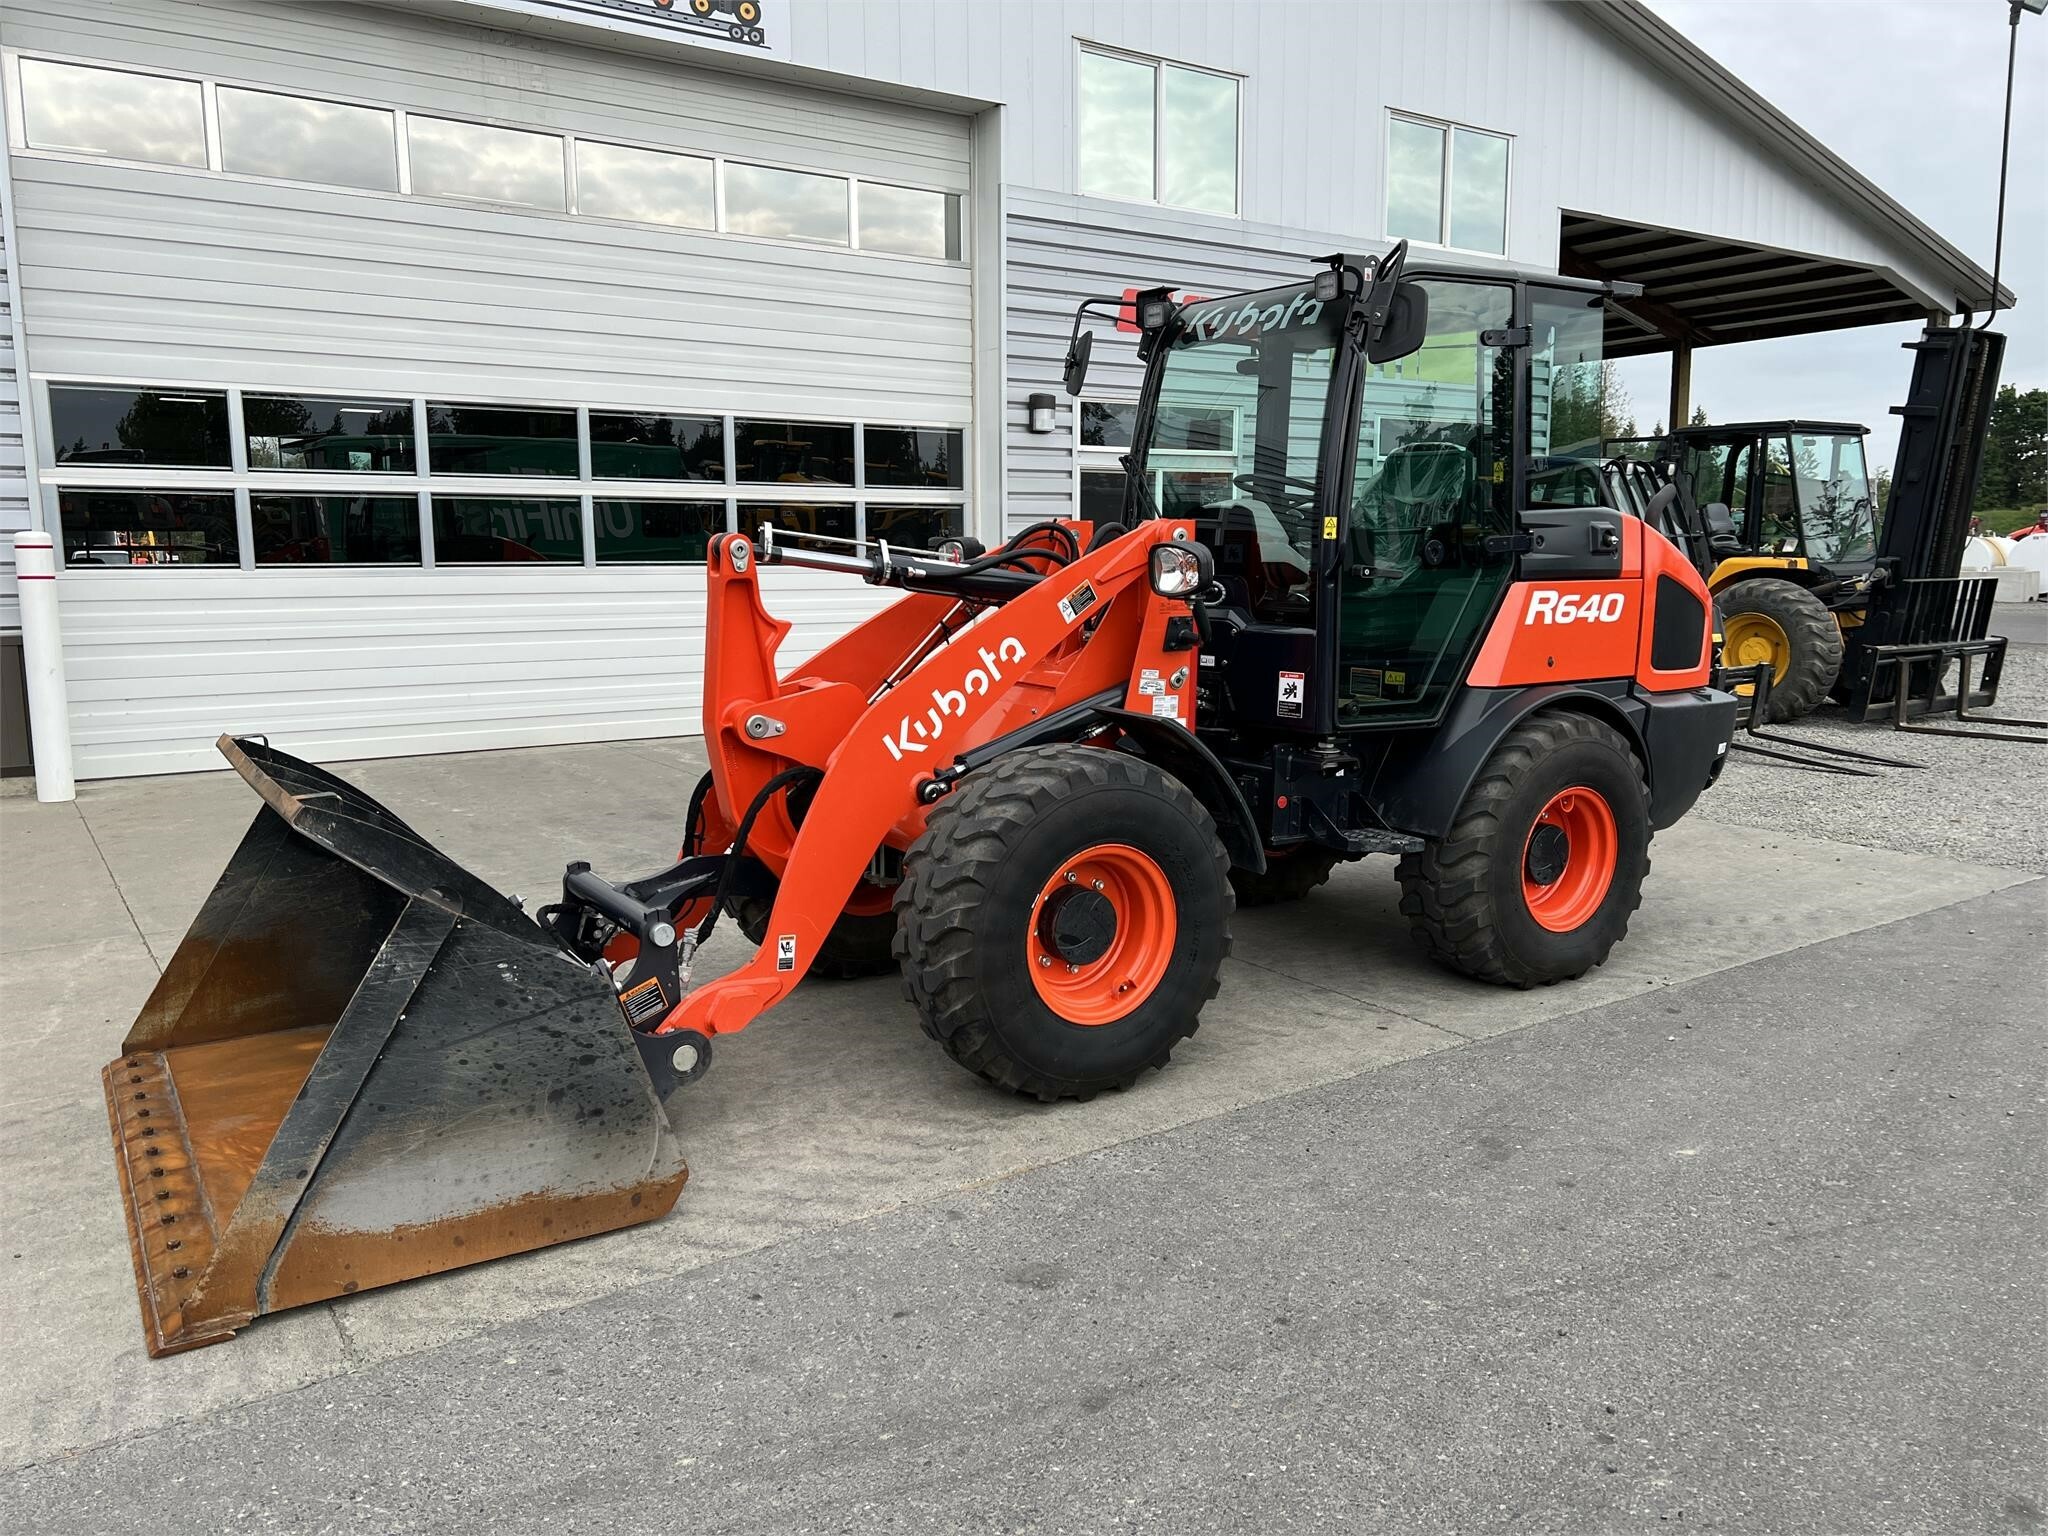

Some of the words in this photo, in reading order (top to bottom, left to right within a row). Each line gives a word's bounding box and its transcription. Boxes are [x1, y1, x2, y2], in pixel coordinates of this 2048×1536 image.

[1186, 292, 1324, 341] Kubota
[1524, 590, 1625, 626] R640
[881, 636, 1027, 762] Kubota
